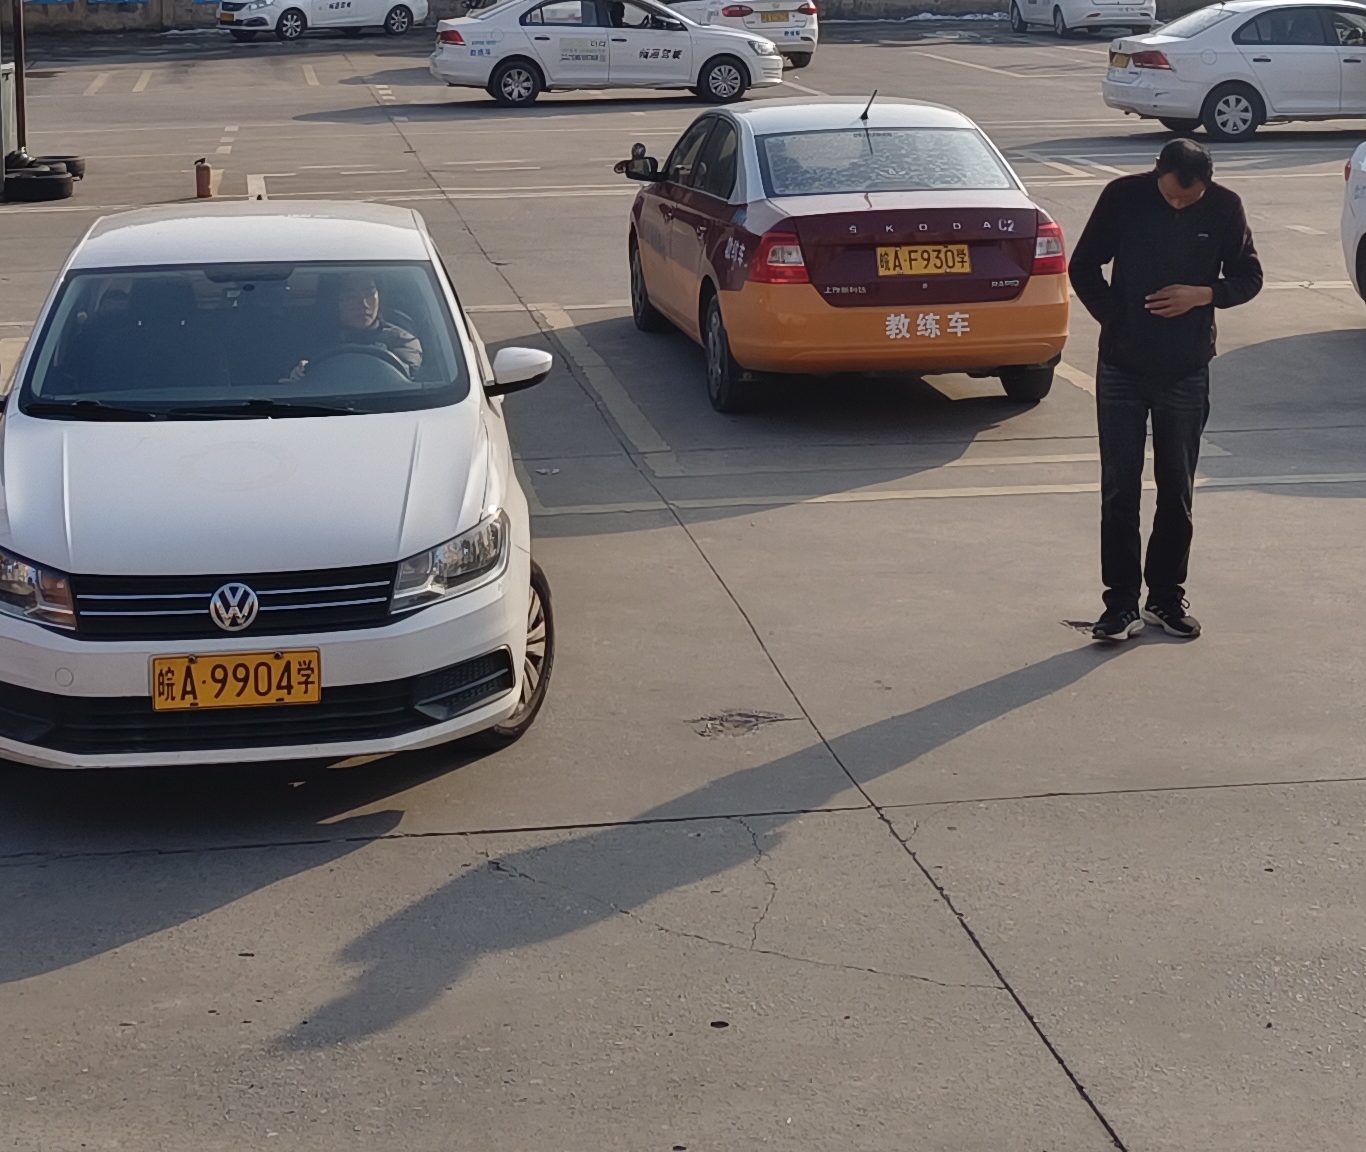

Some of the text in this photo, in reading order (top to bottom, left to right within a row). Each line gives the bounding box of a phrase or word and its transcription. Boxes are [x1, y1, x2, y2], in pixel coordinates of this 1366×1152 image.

[849, 221, 991, 233] SKODA
[998, 219, 1015, 232] C2
[885, 311, 970, 339] 教练车
